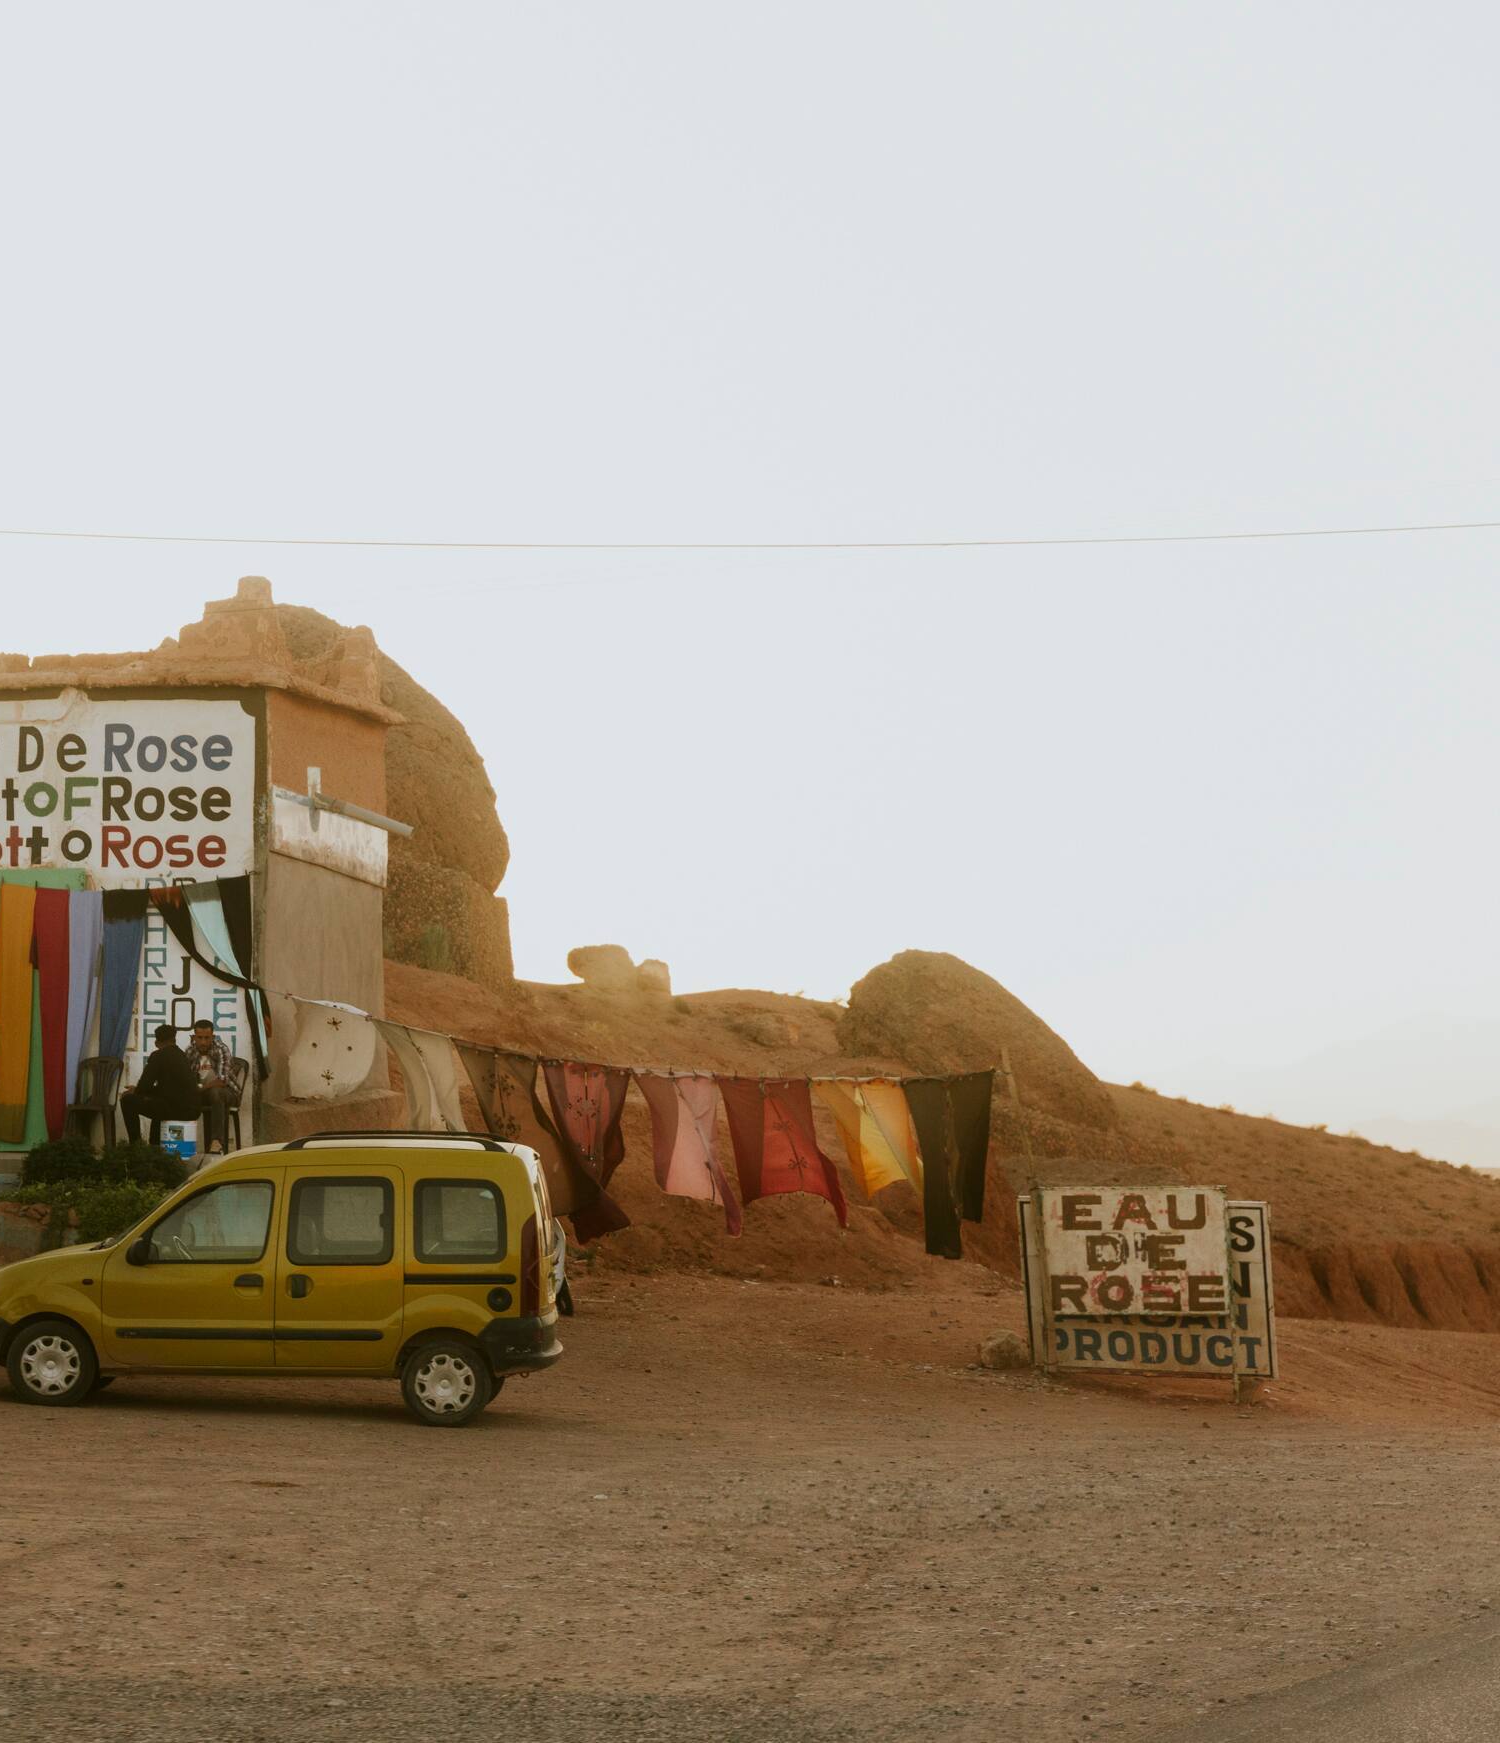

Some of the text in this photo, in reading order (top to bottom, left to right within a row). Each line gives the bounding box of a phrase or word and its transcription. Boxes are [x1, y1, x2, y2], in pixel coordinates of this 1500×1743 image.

[18, 726, 87, 773] De
[104, 723, 233, 773] Rose
[102, 776, 232, 822] Rose
[101, 825, 227, 869] Rose
[1061, 1193, 1206, 1231] EAU
[1051, 1274, 1226, 1312] ROSE
